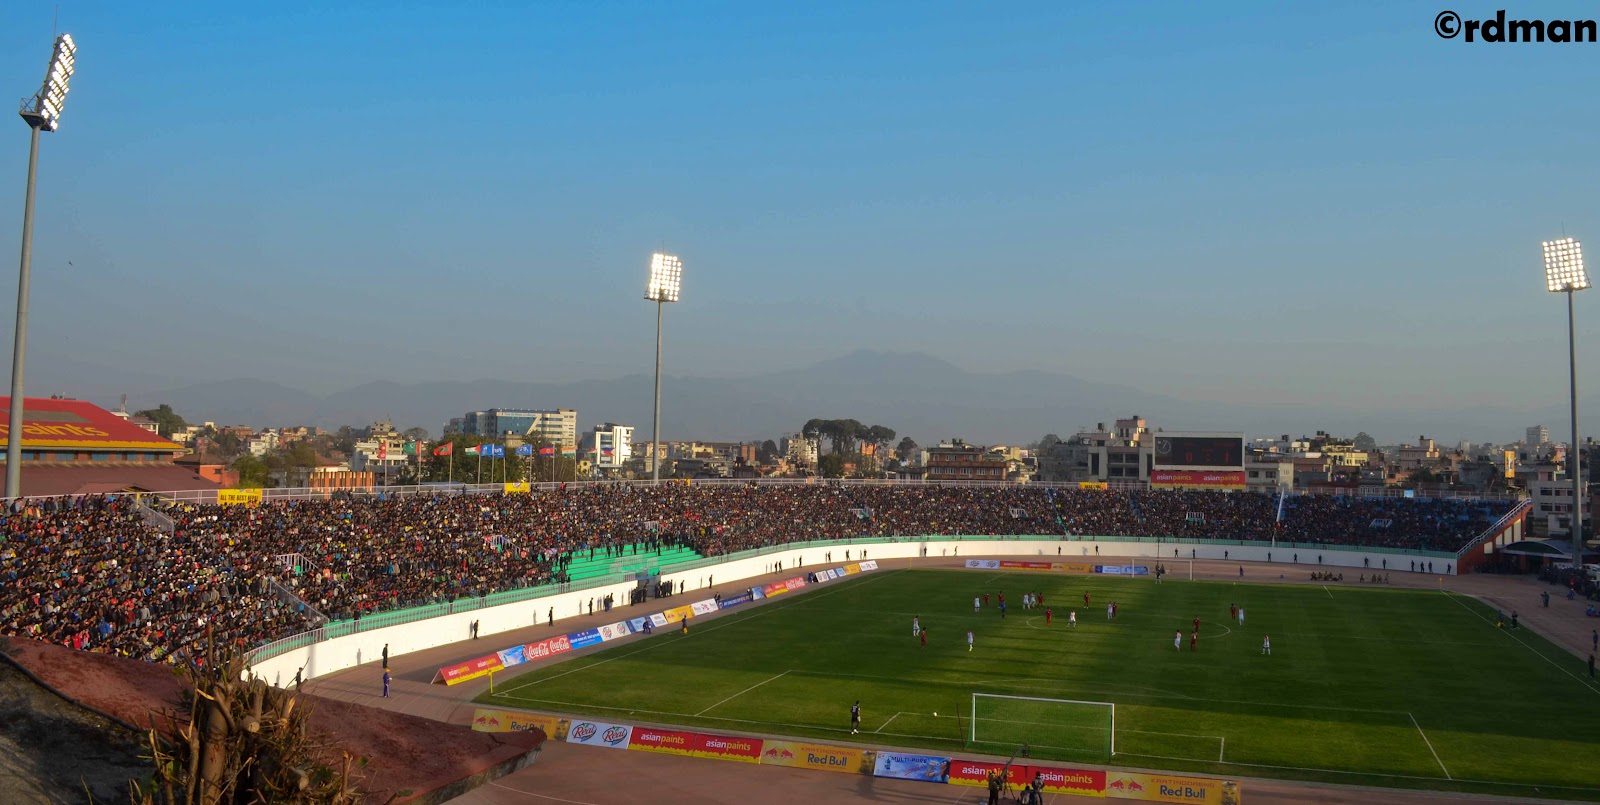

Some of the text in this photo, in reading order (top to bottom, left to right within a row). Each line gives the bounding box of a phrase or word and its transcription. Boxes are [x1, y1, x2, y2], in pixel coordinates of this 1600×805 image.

[573, 725, 595, 739] Real
[603, 729, 626, 743] Real
[807, 753, 828, 765] Red
[829, 756, 848, 767] Bull
[1160, 784, 1183, 797] Red
[1185, 786, 1206, 799] Bull
